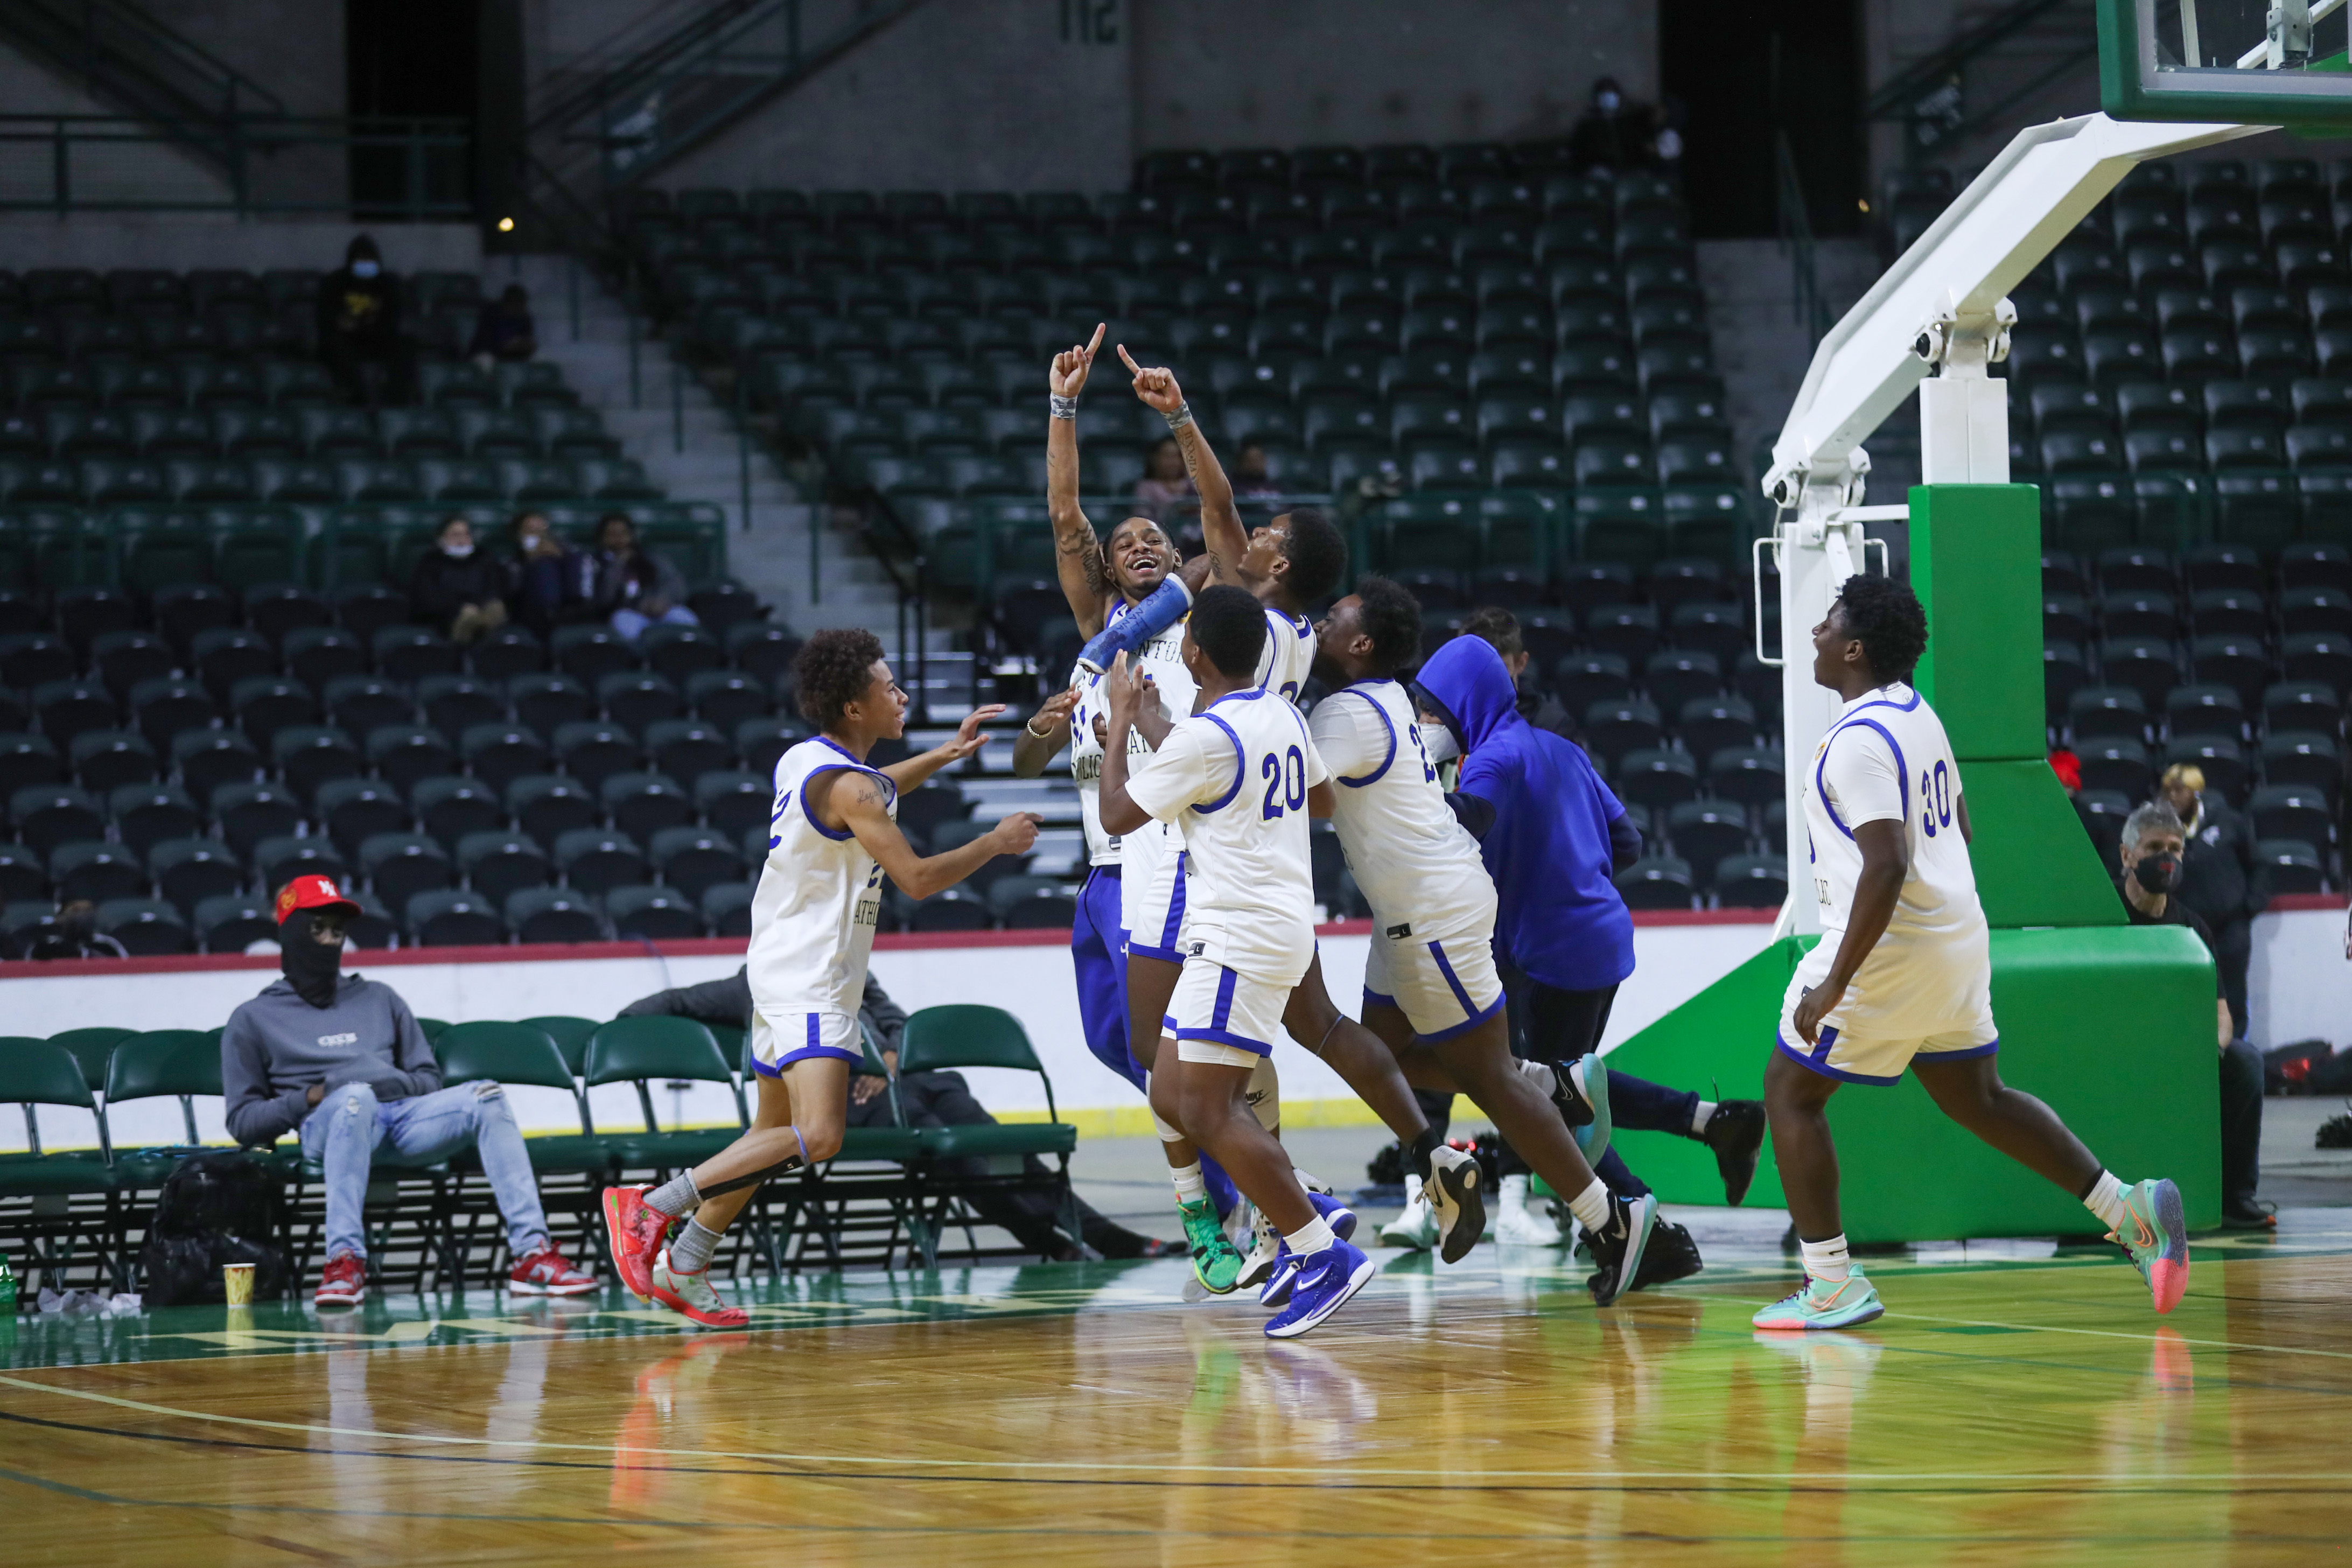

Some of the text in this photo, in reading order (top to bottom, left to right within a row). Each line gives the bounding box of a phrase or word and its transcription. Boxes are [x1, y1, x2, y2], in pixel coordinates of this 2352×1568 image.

[1126, 730, 1147, 755] AT
[1409, 719, 1436, 785] 2
[1262, 744, 1305, 822] 20
[1921, 759, 1951, 838] 30
